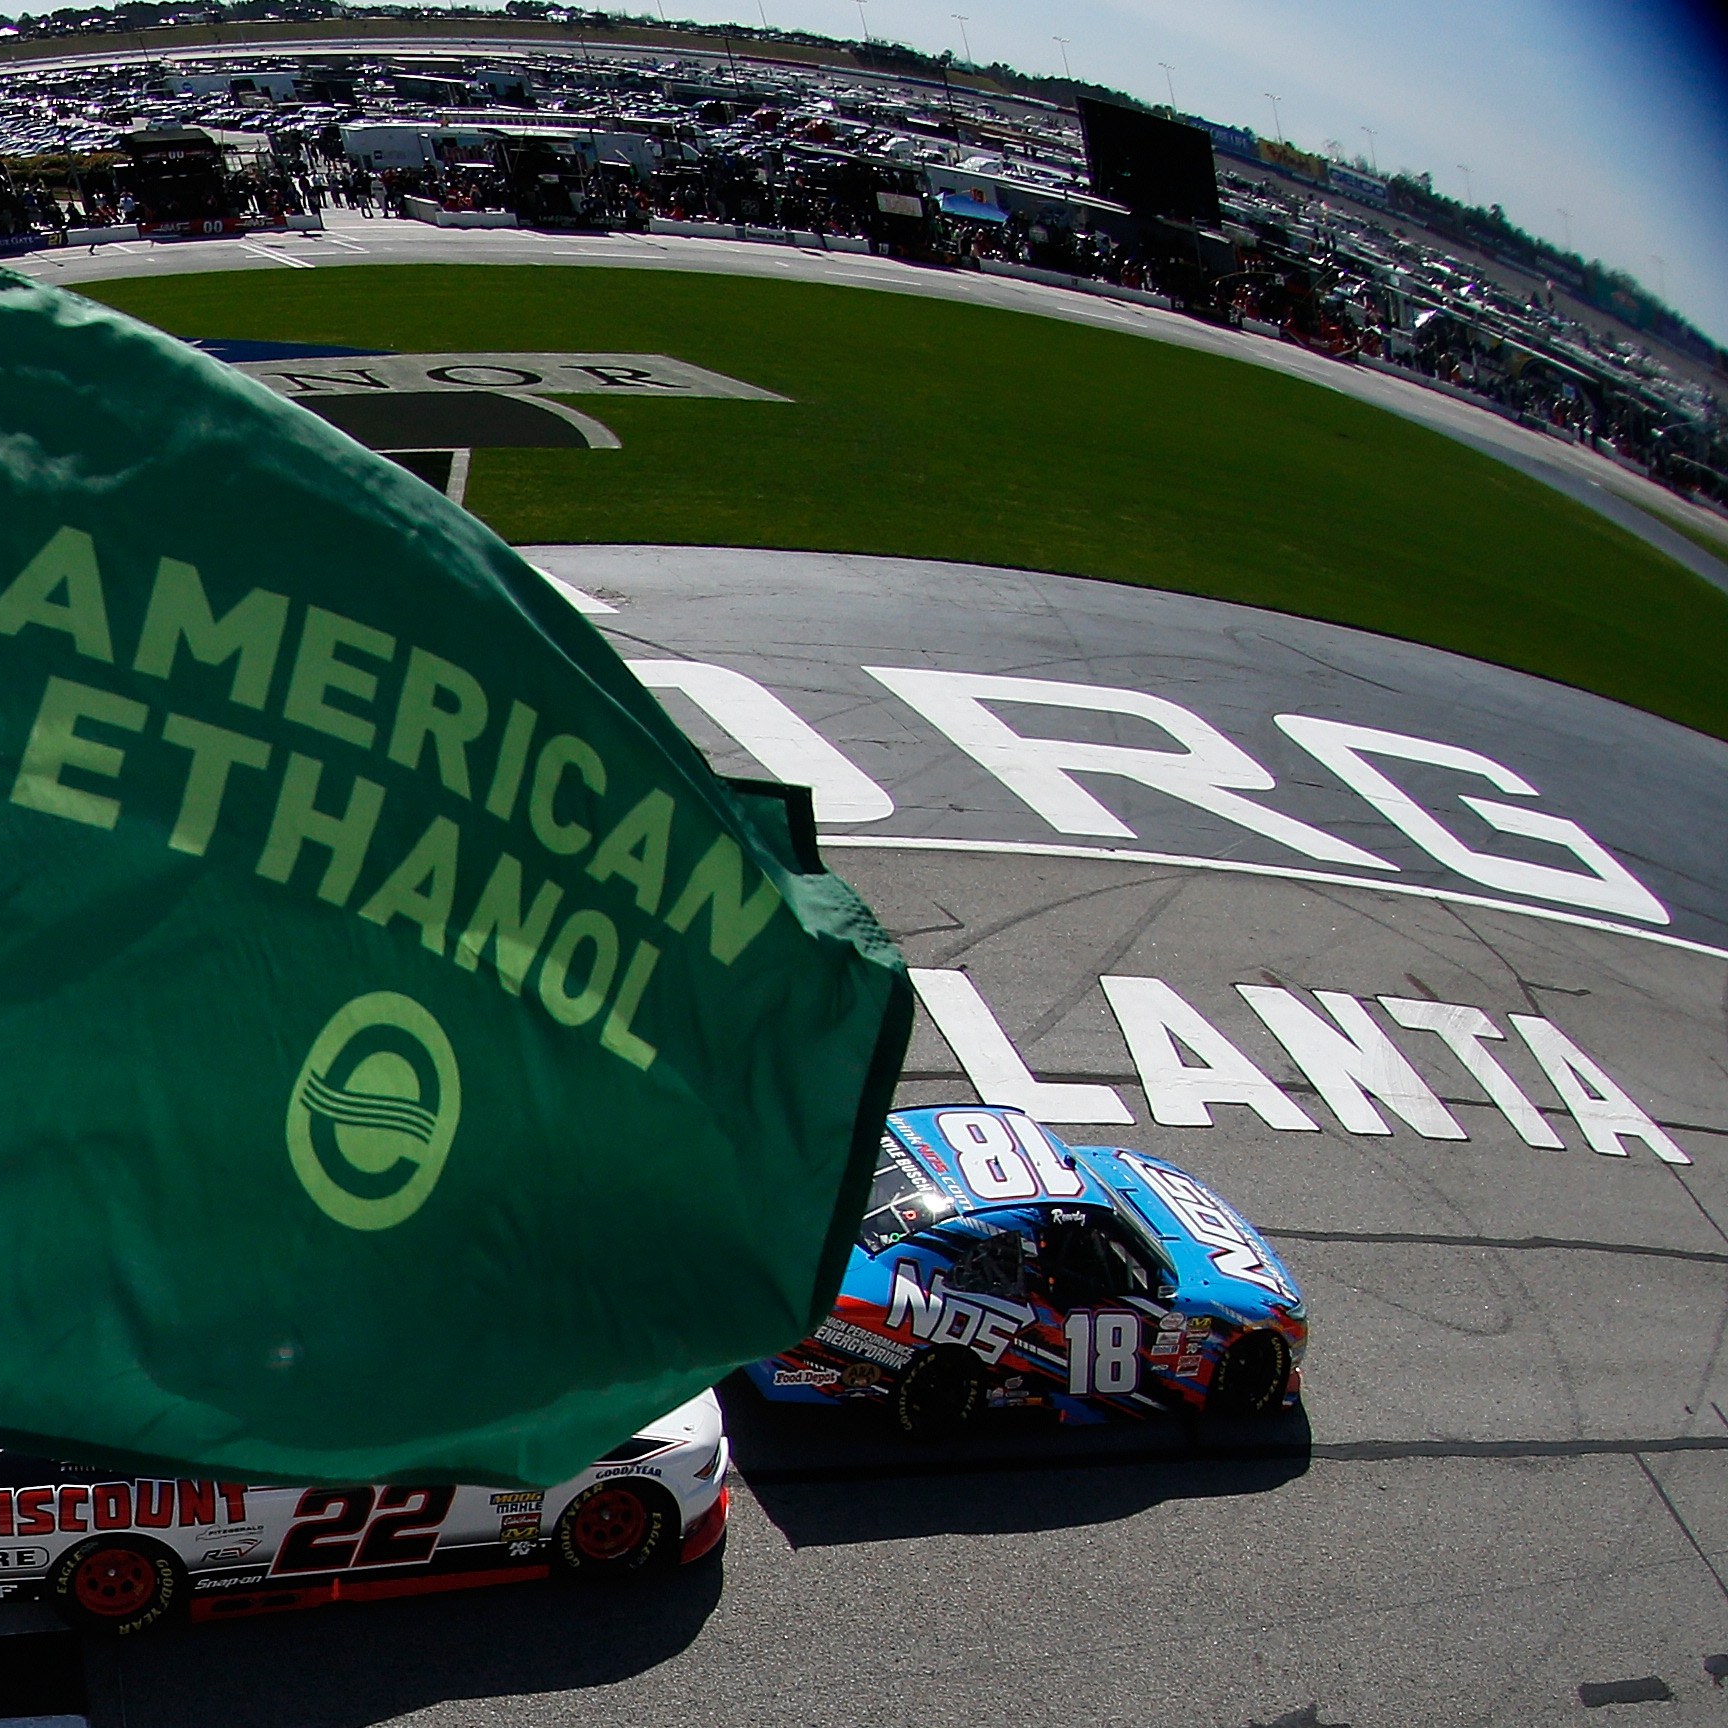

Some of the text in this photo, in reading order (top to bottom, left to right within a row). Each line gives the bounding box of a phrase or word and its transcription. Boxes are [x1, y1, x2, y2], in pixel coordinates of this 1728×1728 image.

[1329, 167, 1387, 198] GEICO
[203, 220, 222, 234] 00
[263, 364, 692, 393] NOR
[9, 674, 661, 1071] ETHANOL
[906, 967, 1692, 1166] LANTA
[880, 1136, 934, 1192] KYLE BUSCH
[933, 1111, 1086, 1201] 18
[885, 1258, 1036, 1365] NOS
[813, 1325, 911, 1370] ENERGY DRINK
[847, 1323, 915, 1357] PERFORMANCE
[1064, 1309, 1141, 1397] 18
[775, 1370, 837, 1386] Food Depot
[492, 1492, 543, 1504] MOOG
[495, 1503, 543, 1514] MAHLE
[208, 1525, 265, 1537] FITZGERALD
[266, 1484, 458, 1578] 22
[57, 1551, 85, 1595] EAGLE
[194, 1575, 263, 1590] Snap-on
